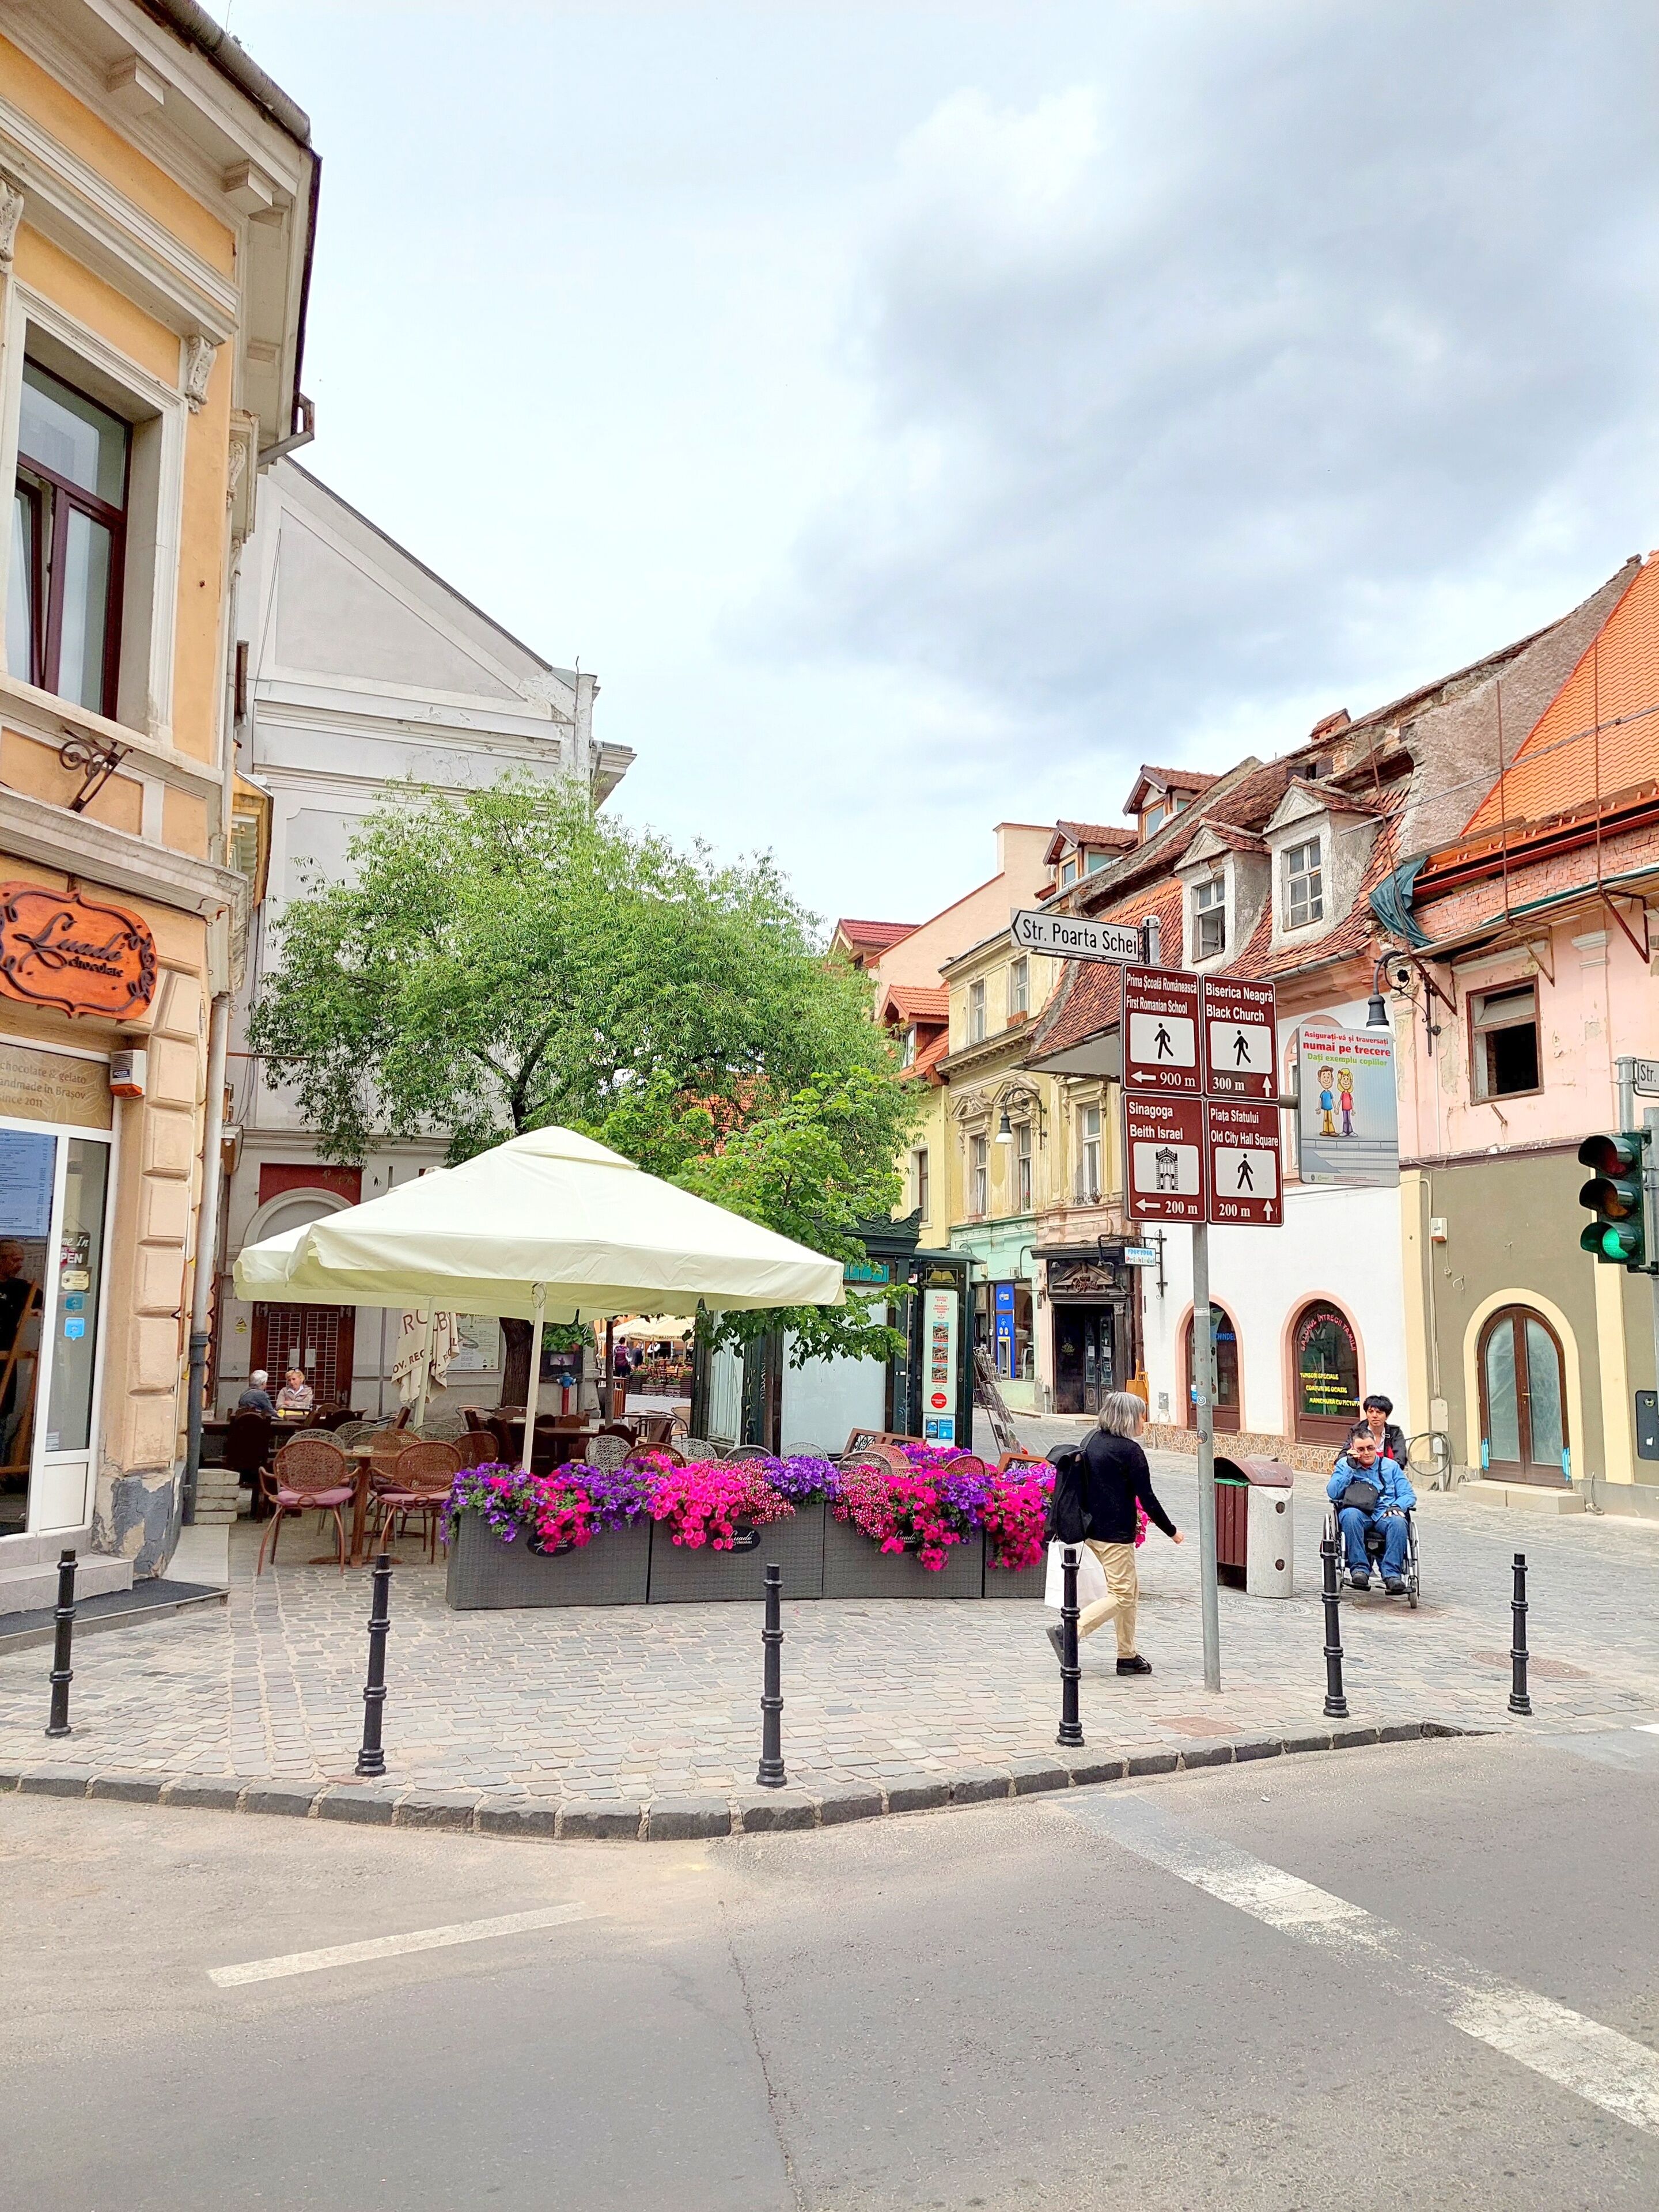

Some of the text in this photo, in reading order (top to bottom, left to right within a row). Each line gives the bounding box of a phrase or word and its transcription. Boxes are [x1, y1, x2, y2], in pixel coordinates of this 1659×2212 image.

[1023, 919, 1137, 955] Str. Poarta Schei
[67, 956, 124, 978] chocolate
[1127, 973, 1142, 987] Prima
[1162, 978, 1197, 994] Românească
[1206, 983, 1273, 1005] Biserica Neagră
[1126, 995, 1188, 1014] First Romanian School
[1206, 1004, 1265, 1022] Black Church
[1303, 1042, 1391, 1056] numai pe trecere
[1325, 1055, 1357, 1065] exemplu
[0, 1060, 86, 1084] chocolate & gelato
[1160, 1072, 1196, 1087] 900 m
[1641, 1064, 1657, 1082] Str.
[44, 1084, 53, 1094] in
[1213, 1077, 1245, 1091] 300 m
[24, 1097, 43, 1108] 2011
[1128, 1101, 1173, 1120] Sinagoga
[1231, 1109, 1259, 1124] Sfatului
[1130, 1124, 1183, 1140] Beith Israel
[1211, 1130, 1279, 1149] Old City Hall Square
[1165, 1200, 1198, 1214] 200 m
[1218, 1203, 1251, 1217] 200 m
[76, 1235, 89, 1247] In
[1343, 1324, 1357, 1351] FAMILII
